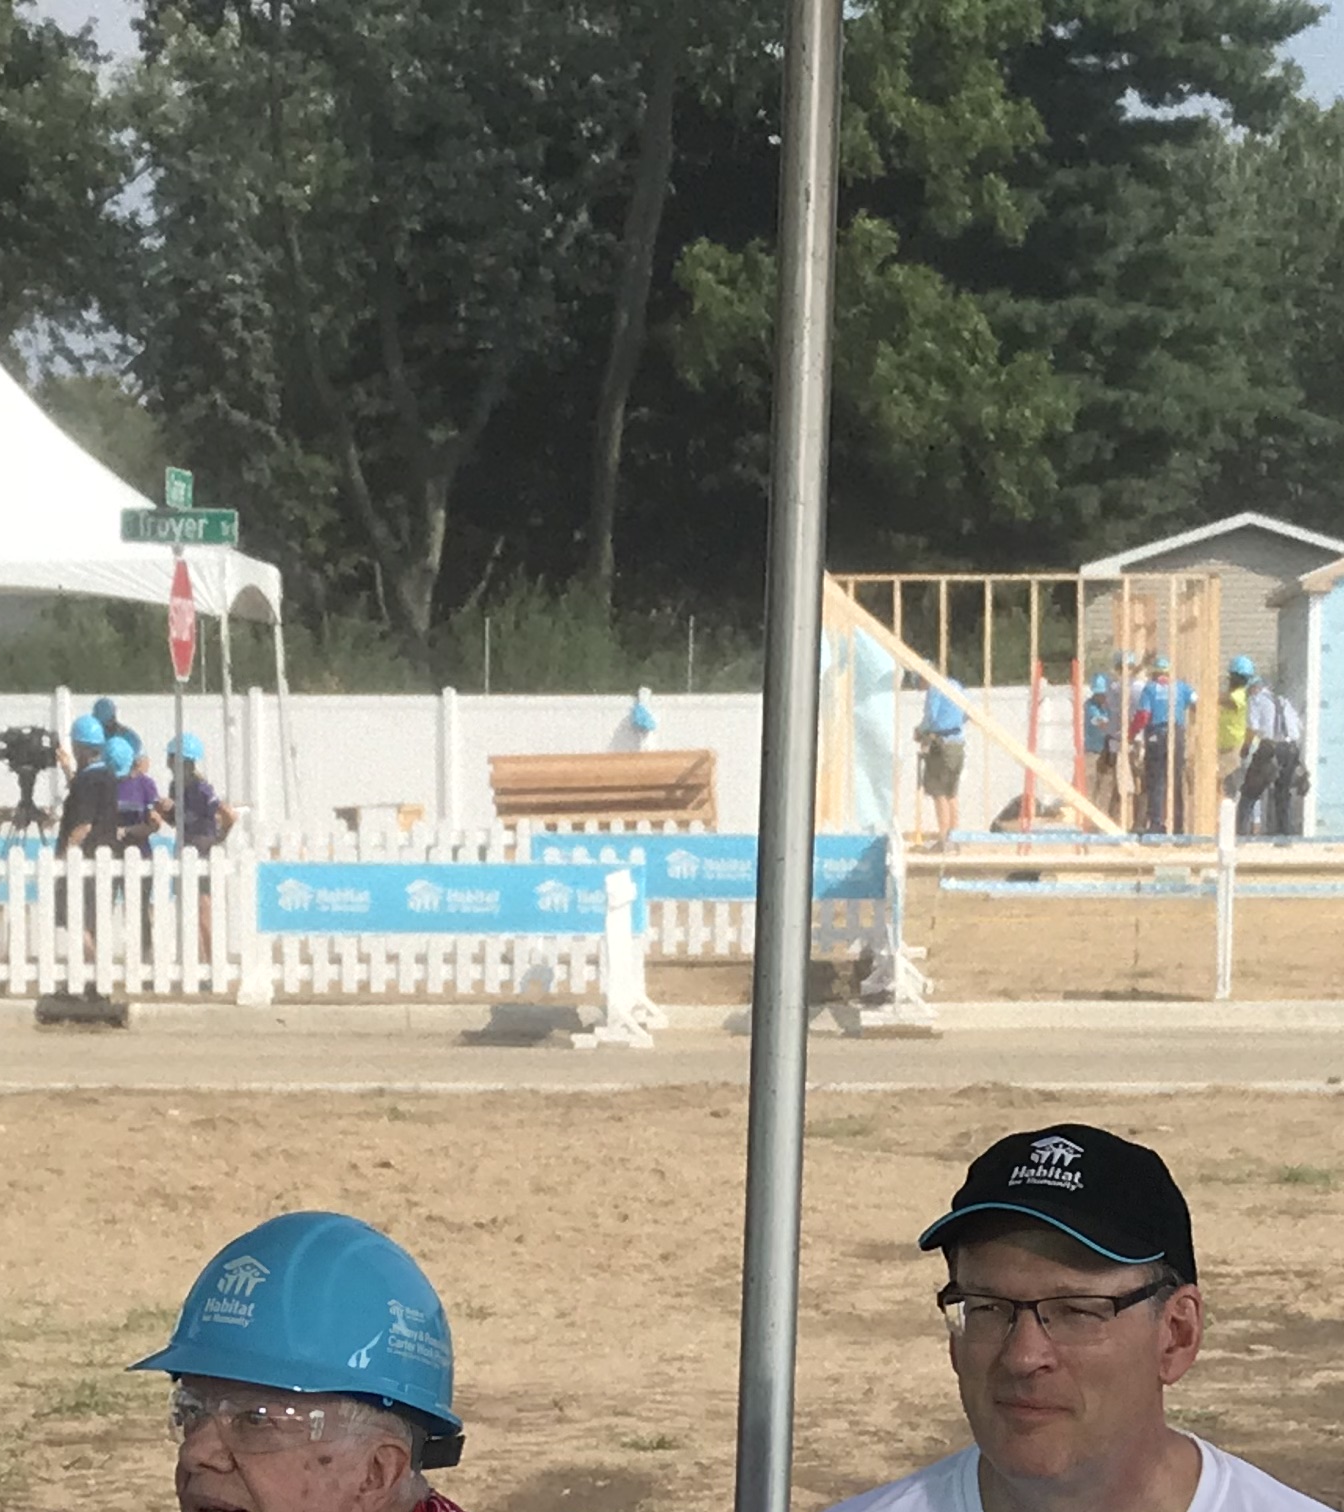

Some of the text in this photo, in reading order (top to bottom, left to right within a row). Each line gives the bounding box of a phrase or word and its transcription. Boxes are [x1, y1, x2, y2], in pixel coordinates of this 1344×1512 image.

[139, 510, 209, 542] Troyer
[1011, 1165, 1082, 1184] Habitat
[204, 1297, 255, 1317] Habitat
